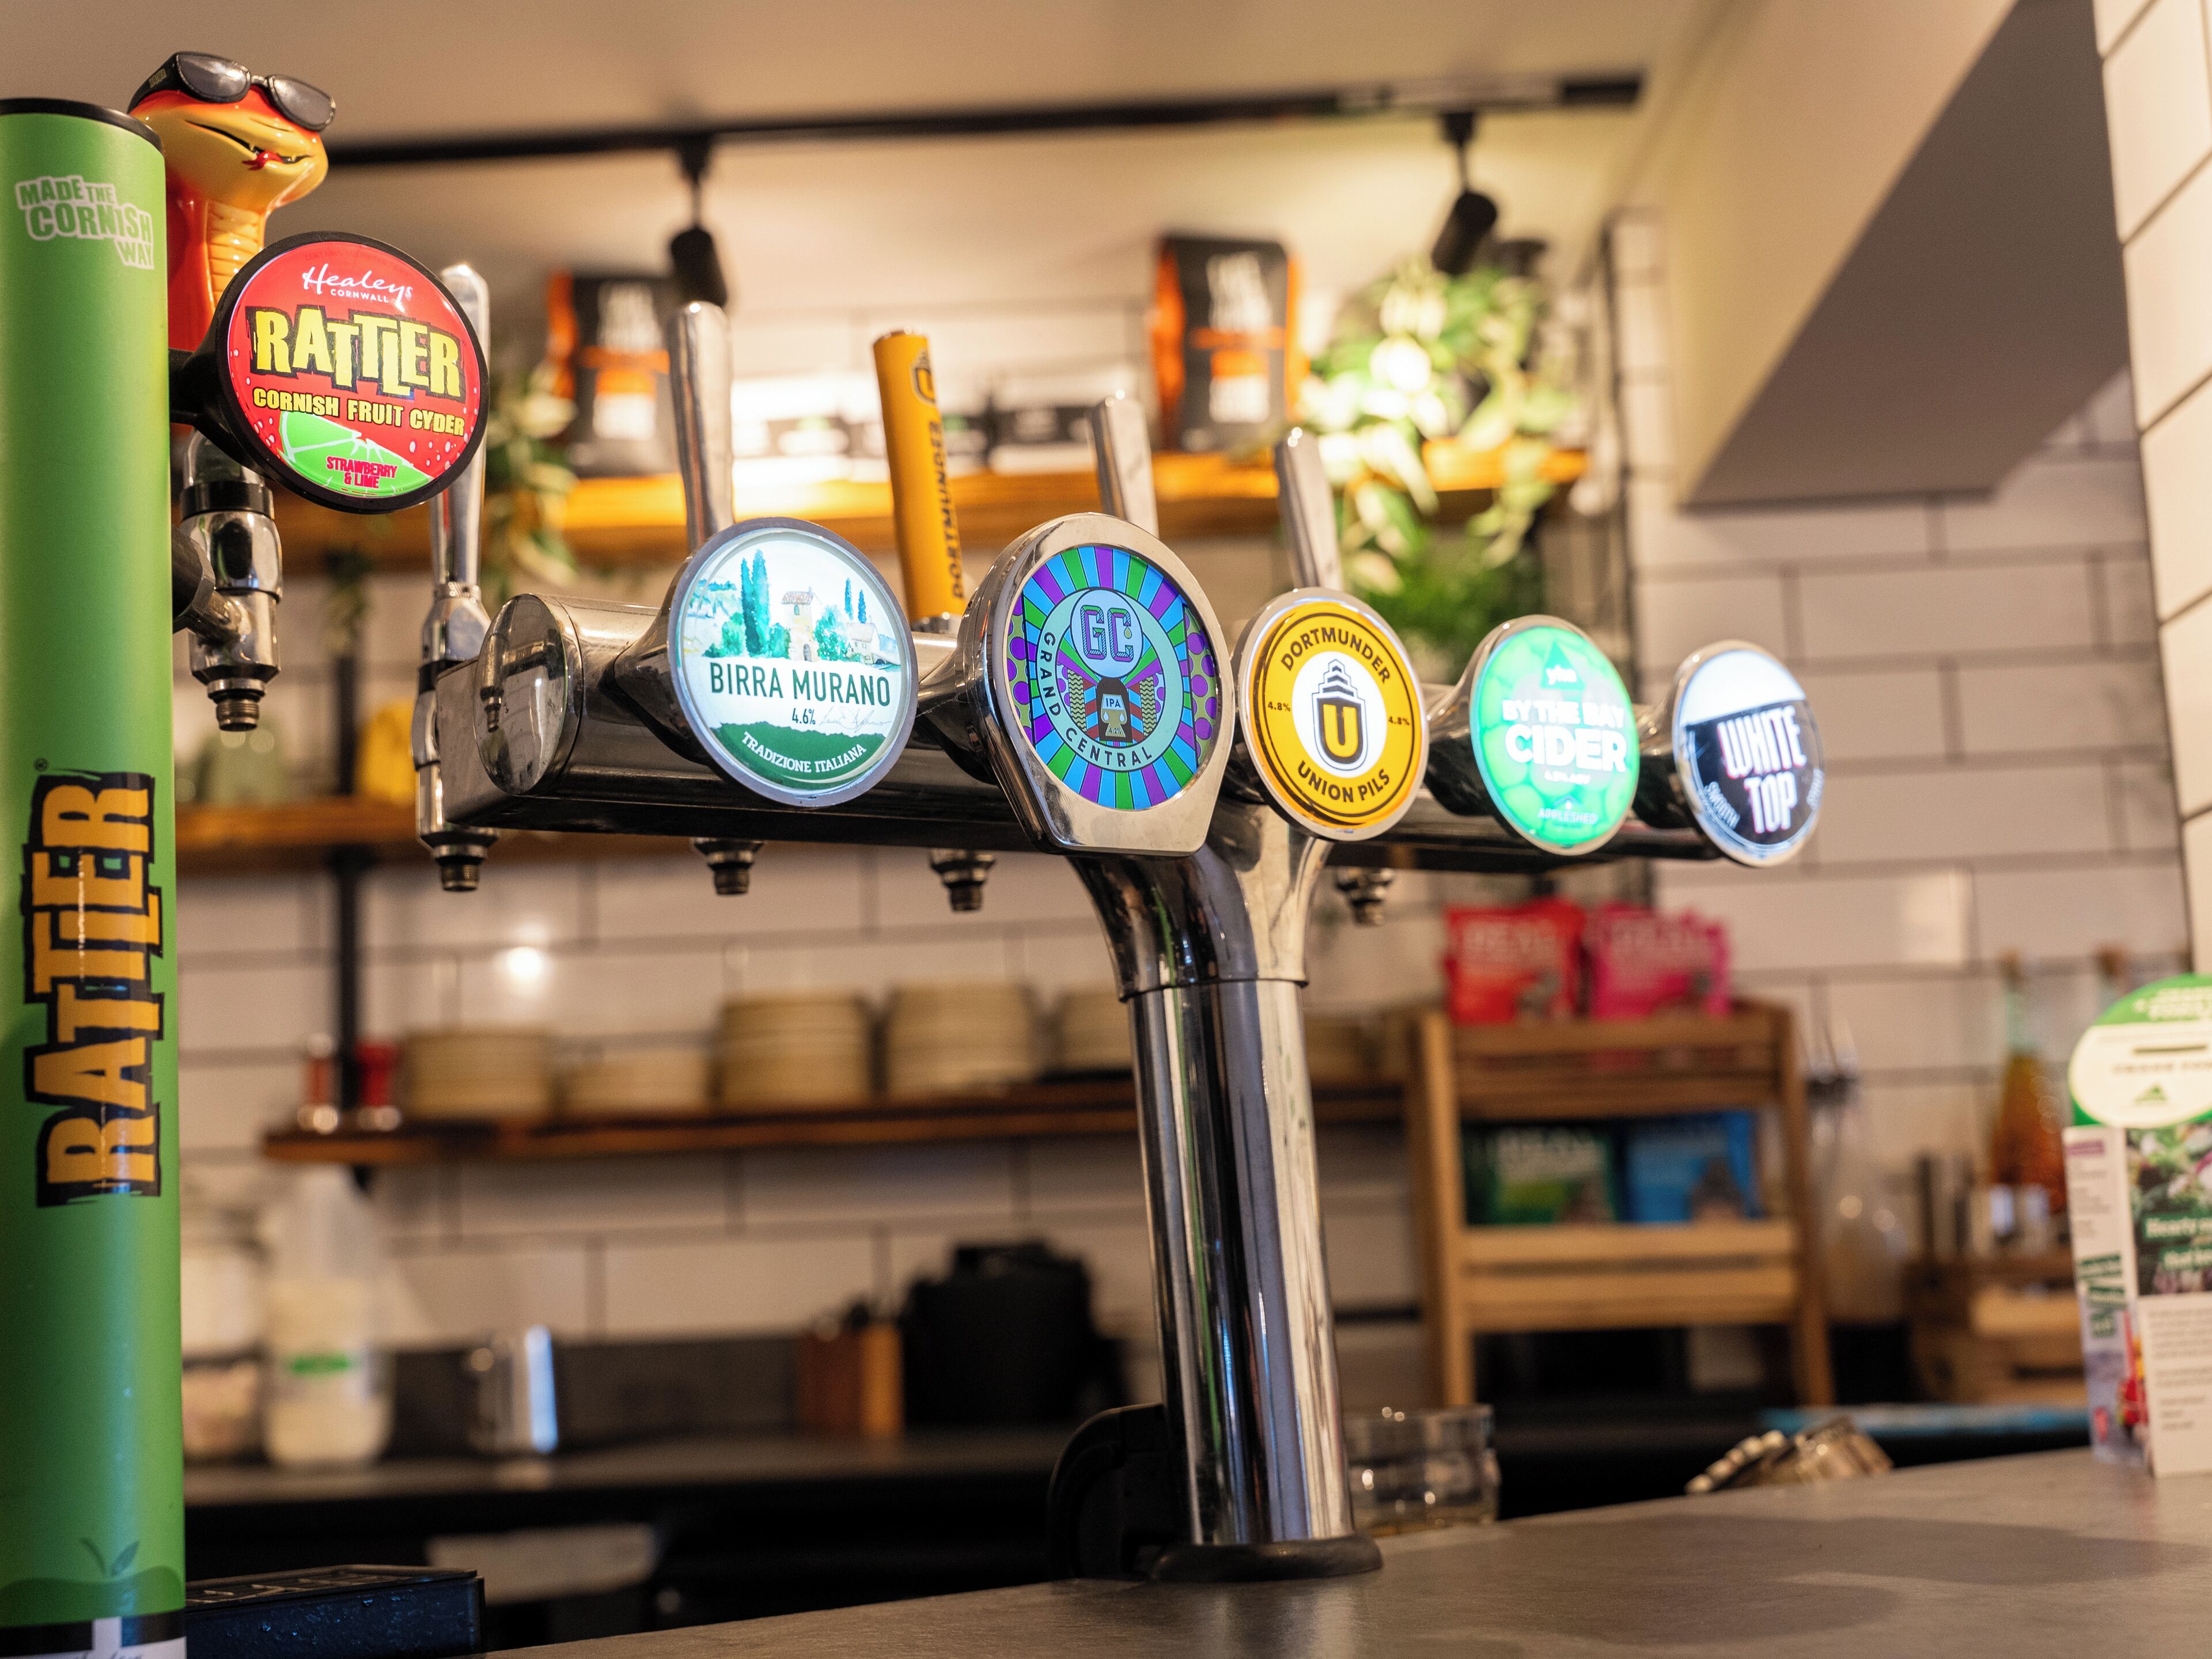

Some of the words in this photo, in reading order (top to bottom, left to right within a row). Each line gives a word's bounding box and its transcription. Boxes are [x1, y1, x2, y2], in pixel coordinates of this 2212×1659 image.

[18, 177, 84, 206] MADE
[86, 185, 115, 203] THE
[29, 203, 152, 242] CORNISH
[117, 241, 153, 267] WAY
[330, 289, 389, 304] CORNWALL
[250, 306, 463, 399] RATTLER
[253, 388, 339, 416] CORNISH
[347, 400, 404, 427] FRUIT
[409, 409, 465, 436] CYDER
[326, 456, 398, 479] STRAWBERRY
[344, 472, 352, 485] &
[354, 474, 380, 489] LIME
[1080, 605, 1135, 662] GC
[1281, 627, 1391, 683] DORTMUNDER
[710, 662, 784, 699] BIRRA
[792, 669, 891, 707] MURANO
[1040, 632, 1061, 716] GRAND
[1066, 727, 1153, 768] CENTRAL
[1106, 698, 1121, 708] IPA
[791, 708, 816, 725] 4.6%
[1268, 701, 1291, 712] 4.8%
[1502, 699, 1532, 722] BY
[741, 732, 812, 773] TRADIZIONE
[815, 744, 866, 773] ITALIANA
[1323, 704, 1358, 758] U
[1505, 724, 1627, 773] CIDER
[1718, 705, 1807, 779] WHITE
[1297, 760, 1354, 803] UNION
[1358, 769, 1391, 801] PILS
[1744, 771, 1798, 834] TOP
[26, 778, 161, 1194] RATTLER
